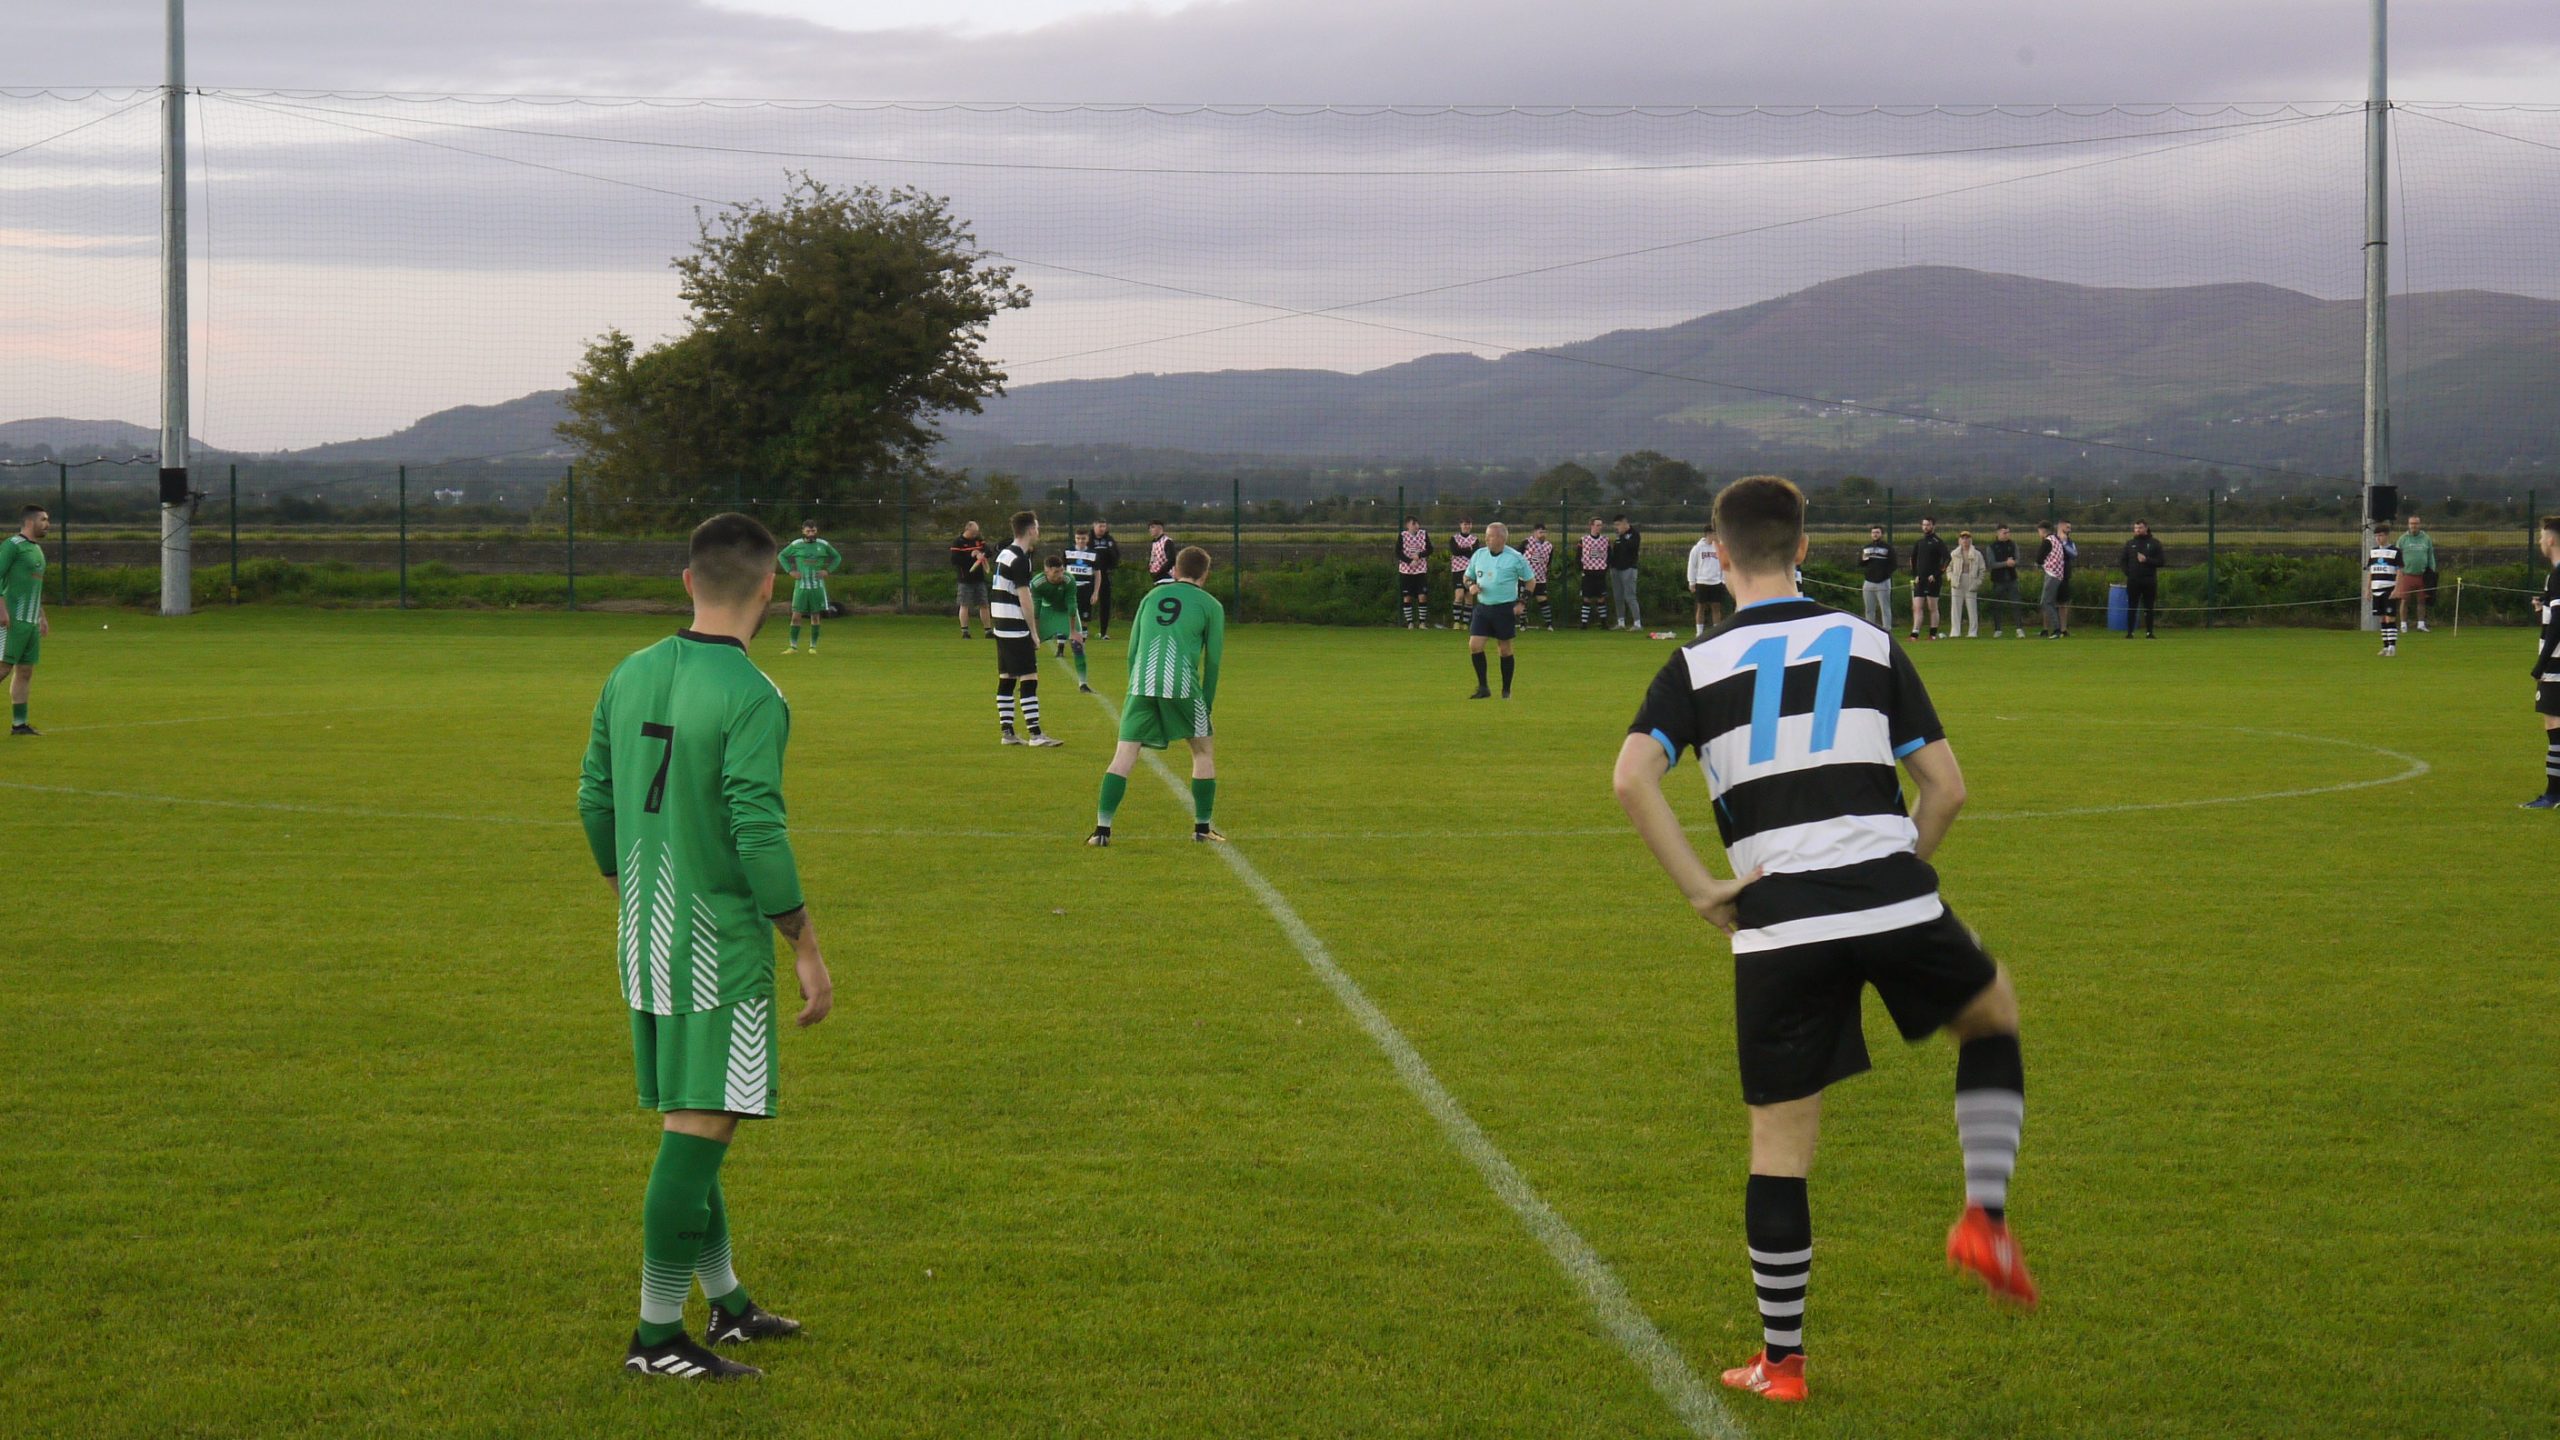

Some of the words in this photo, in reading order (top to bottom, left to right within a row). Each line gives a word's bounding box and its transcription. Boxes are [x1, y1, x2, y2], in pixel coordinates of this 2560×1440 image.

[1156, 597, 1182, 626] 9
[1731, 625, 1854, 765] 11
[640, 722, 674, 814] 7
